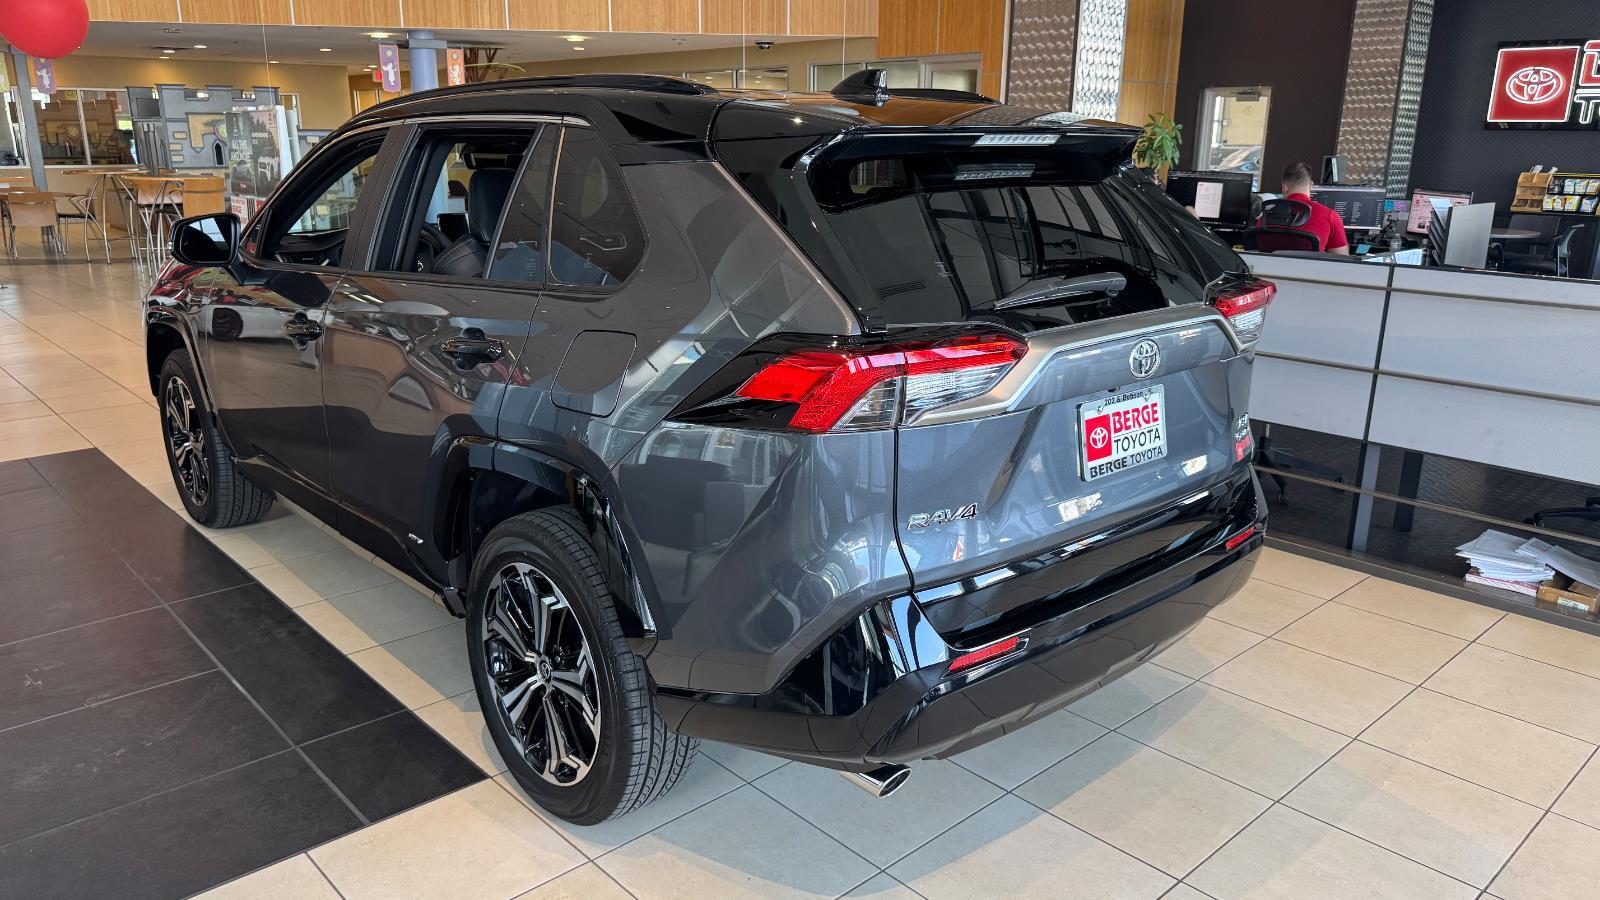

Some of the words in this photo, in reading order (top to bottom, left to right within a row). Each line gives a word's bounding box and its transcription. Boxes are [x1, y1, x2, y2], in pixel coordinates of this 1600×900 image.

[1104, 397, 1115, 406] 202
[1111, 402, 1159, 434] BERGE
[1113, 427, 1161, 454] TOYOTA
[1089, 456, 1128, 479] BERGE
[1130, 446, 1163, 464] TOYOTA
[907, 502, 978, 530] RAV4
